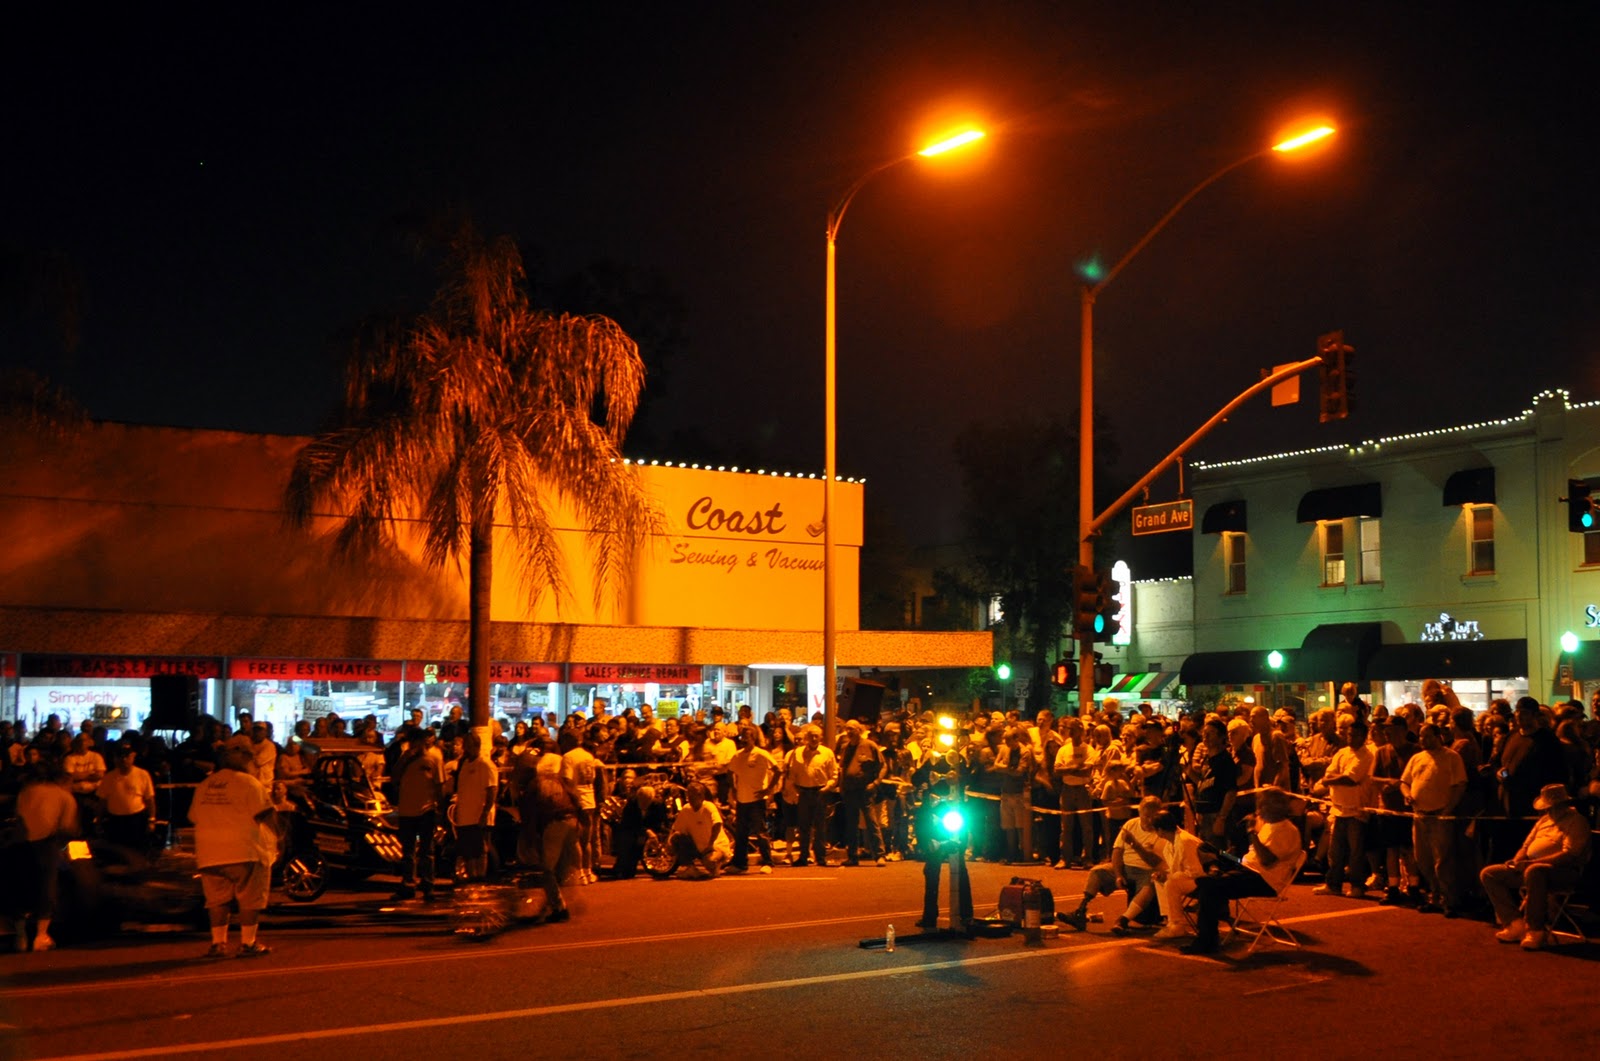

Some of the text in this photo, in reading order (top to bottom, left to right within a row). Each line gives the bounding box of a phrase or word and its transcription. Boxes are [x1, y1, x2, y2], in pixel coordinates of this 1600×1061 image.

[686, 496, 787, 535] Coast
[1135, 509, 1189, 529] Grand Ave
[670, 543, 739, 574] Sewing
[746, 552, 758, 567] &
[249, 663, 382, 677] FREE ESTIMATES
[439, 664, 460, 678] BIG
[48, 690, 119, 706] Simplicity
[1016, 688, 1028, 697] 30
[304, 698, 334, 712] CLOSED
